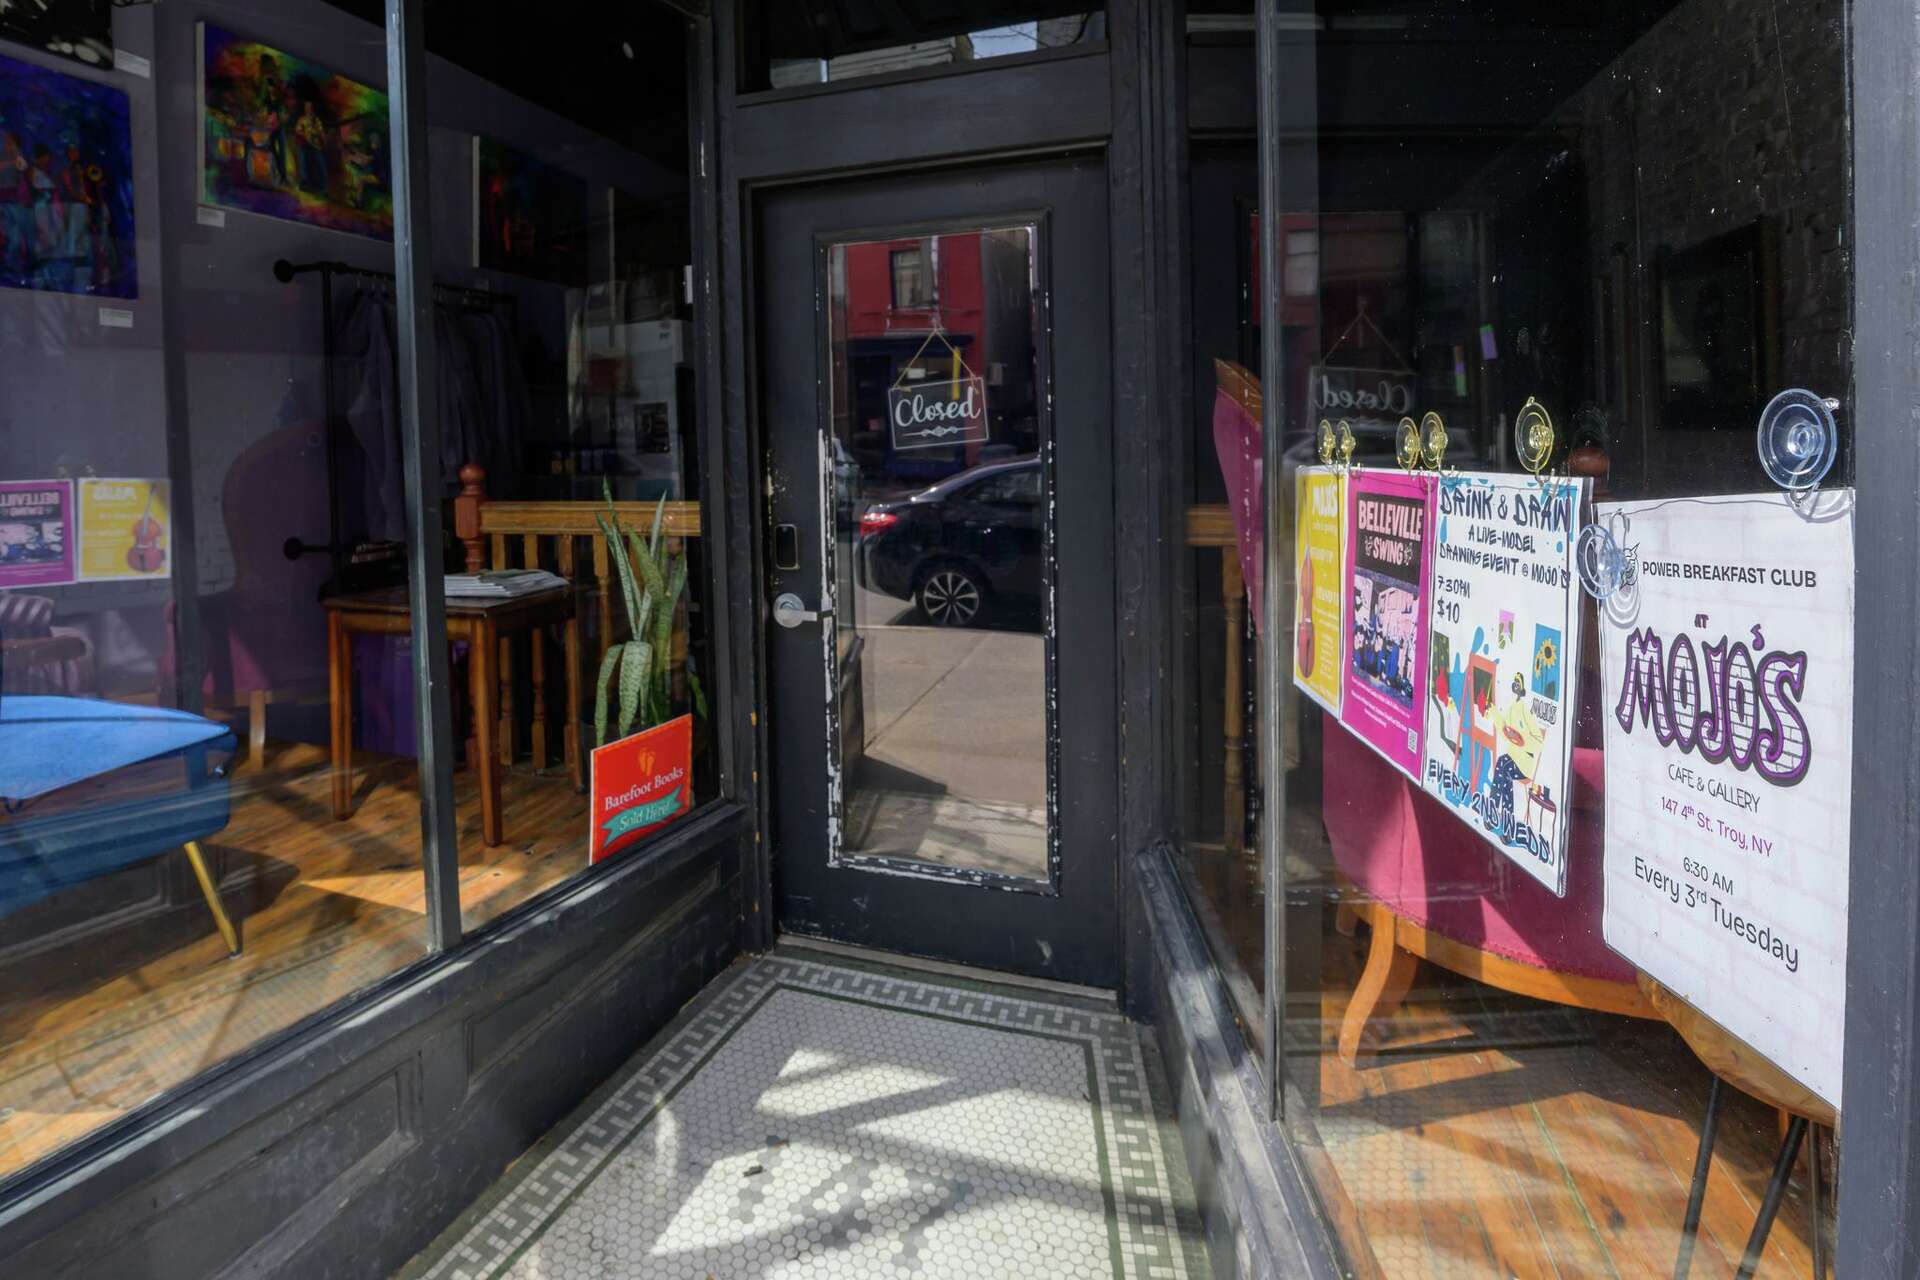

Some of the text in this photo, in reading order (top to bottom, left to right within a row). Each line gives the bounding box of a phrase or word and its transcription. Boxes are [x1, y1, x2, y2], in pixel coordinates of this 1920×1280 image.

[895, 386, 981, 427] Closed
[1358, 500, 1423, 541] BELLEVILLE
[1497, 494, 1508, 520] &
[1513, 494, 1570, 532] DRAW
[1373, 537, 1404, 565] SWING
[1468, 524, 1474, 542] A
[1482, 554, 1519, 575] EVENT
[1522, 564, 1528, 576] @
[1642, 562, 1817, 588] POWER BREAKFAST CLUB
[1438, 596, 1460, 624] $10
[1694, 614, 1710, 628] AT
[1616, 624, 1812, 787] MOJO'S
[605, 766, 684, 811] Barefoot Books
[1428, 758, 1469, 800] EVERY
[1472, 792, 1500, 827] 2ND
[1668, 764, 1760, 814] CAFE & GALLERY
[619, 810, 642, 830] Sold
[1661, 796, 1772, 857] 147 4th St. Troy, NY
[1683, 856, 1734, 895] 6:30 AM
[1635, 856, 1799, 973] Every 3rd Tuesday
